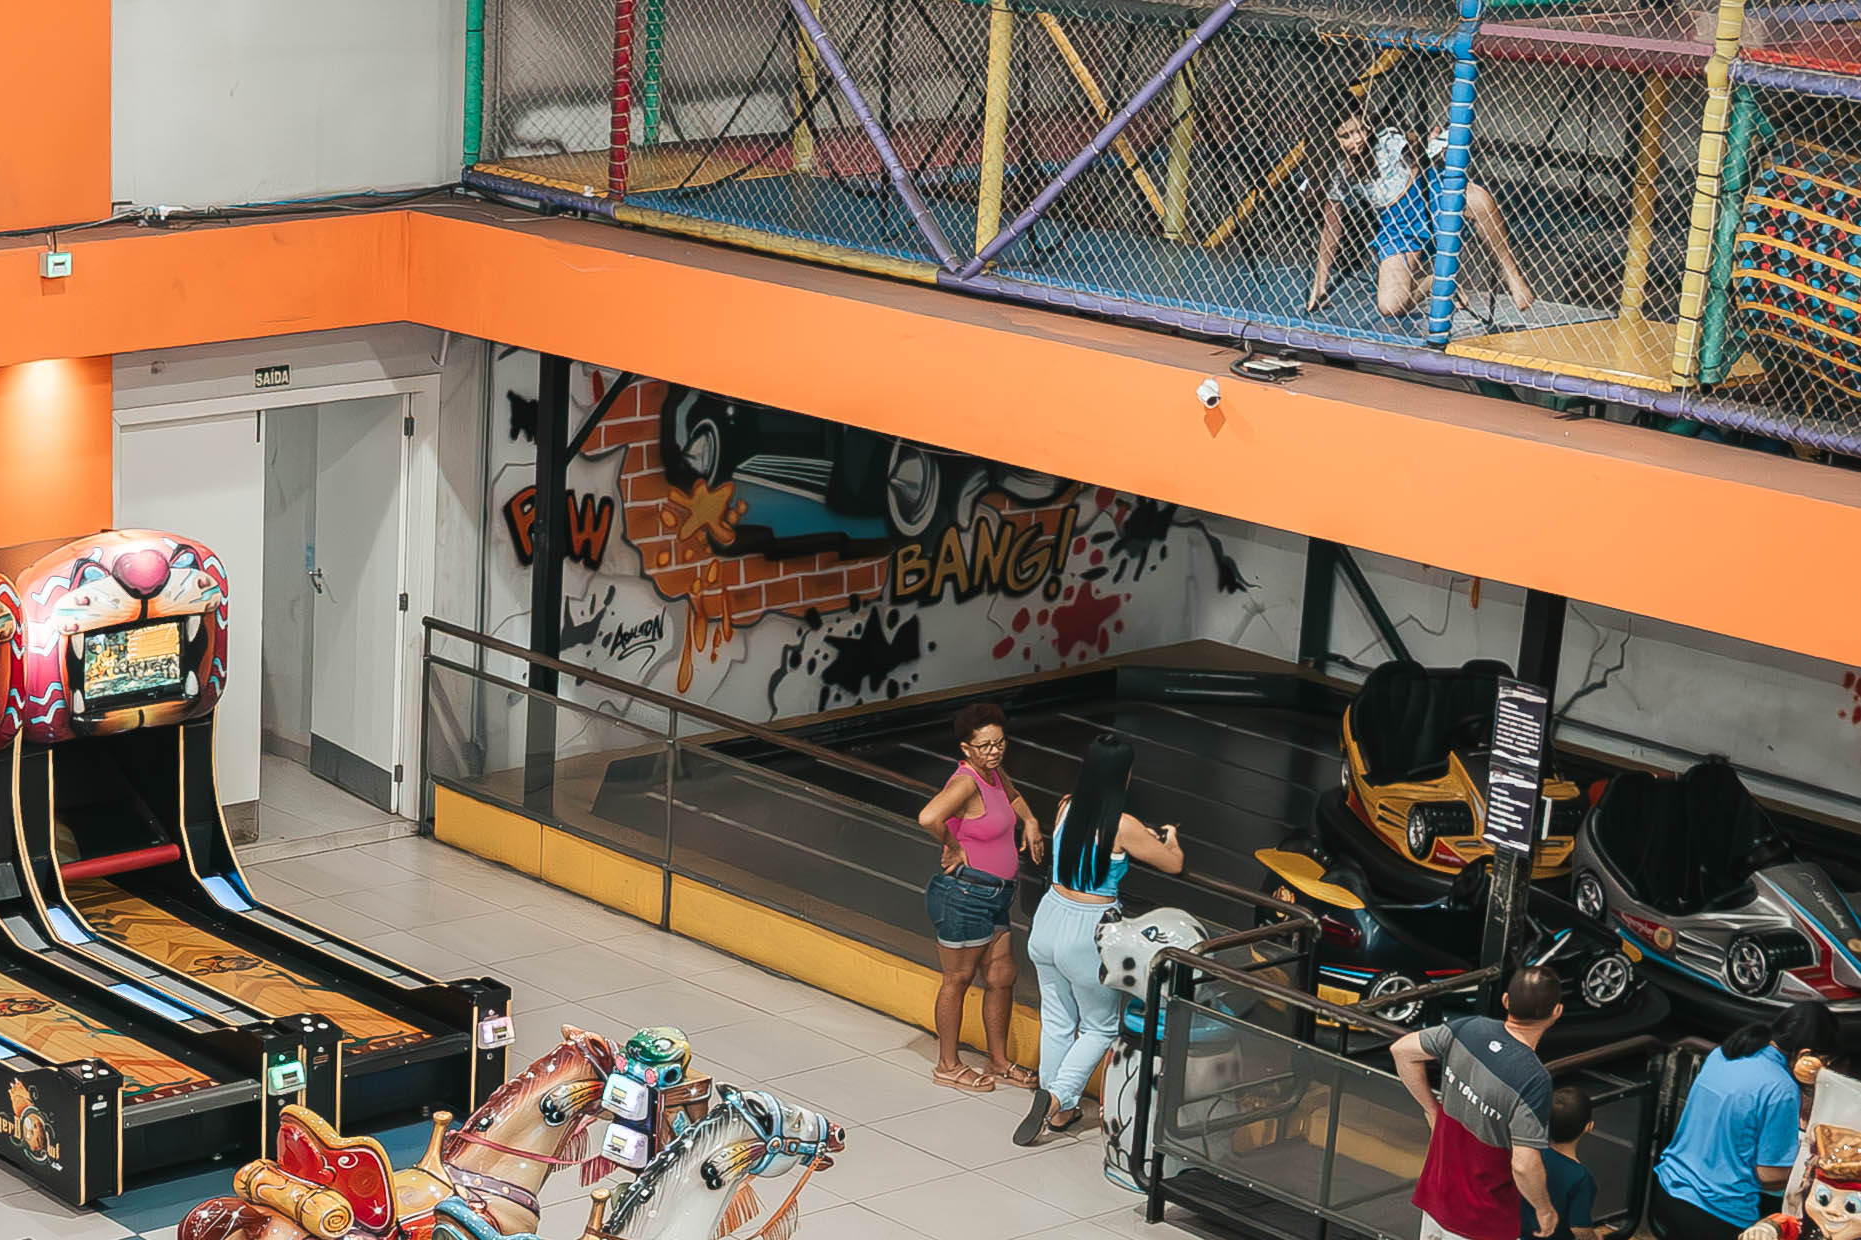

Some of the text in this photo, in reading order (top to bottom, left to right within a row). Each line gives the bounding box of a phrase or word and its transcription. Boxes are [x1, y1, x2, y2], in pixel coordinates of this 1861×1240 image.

[255, 367, 289, 387] SAÍDA
[504, 485, 615, 571] PW
[895, 505, 1080, 608] BANG!
